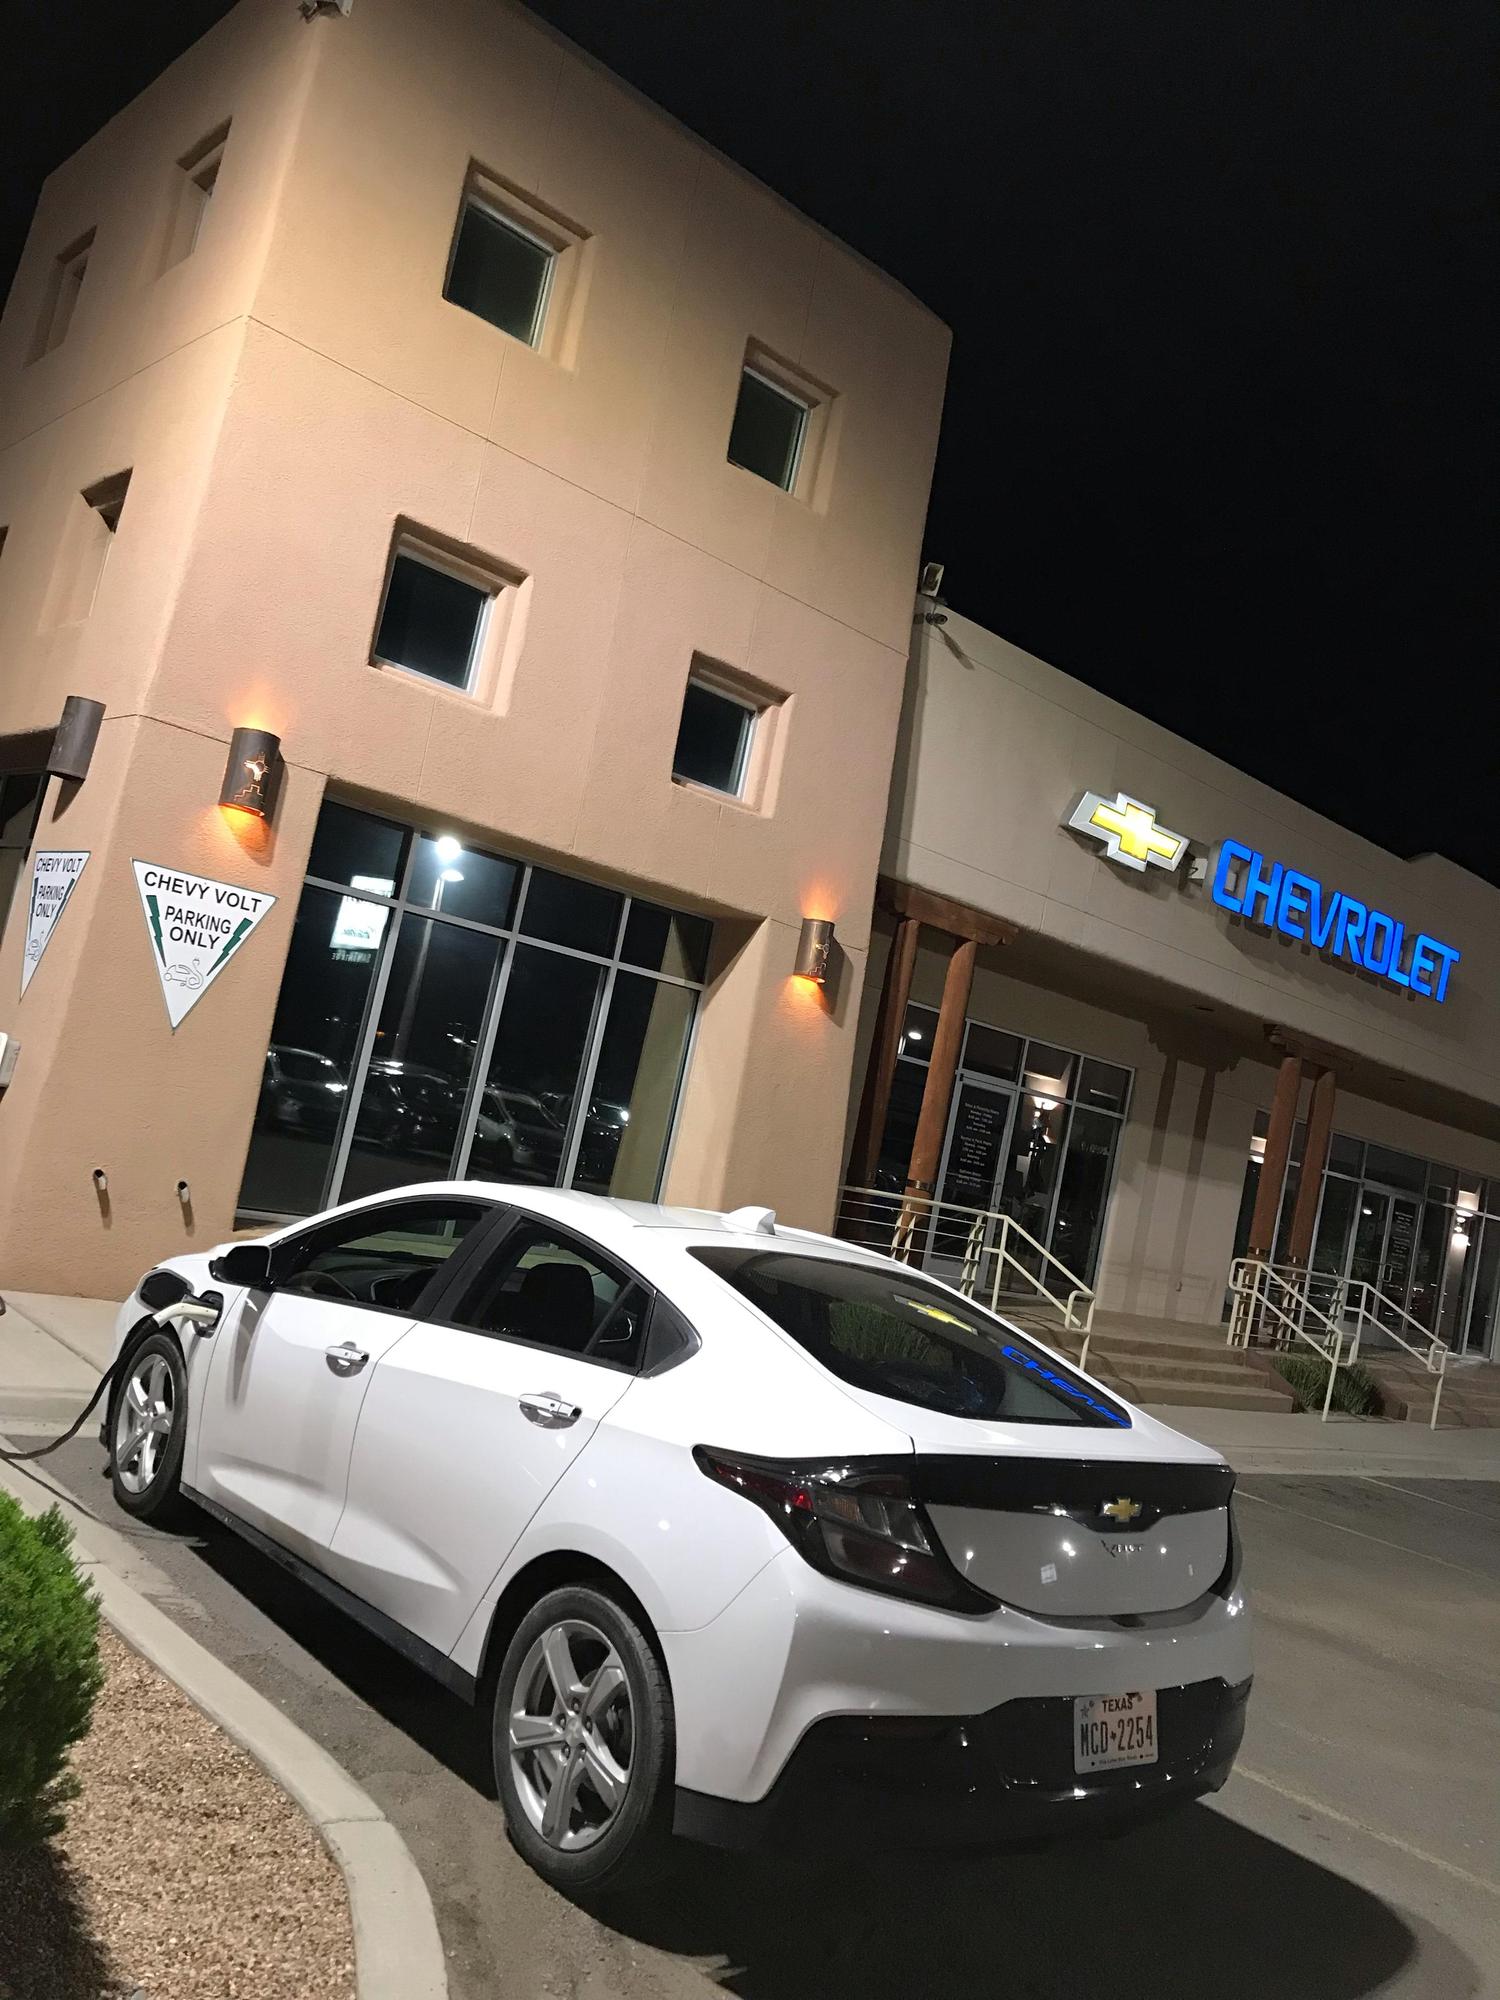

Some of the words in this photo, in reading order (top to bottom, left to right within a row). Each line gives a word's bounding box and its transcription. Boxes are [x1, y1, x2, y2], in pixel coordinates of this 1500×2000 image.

[36, 858, 61, 873] CHEVY
[61, 858, 83, 873] VOLT
[38, 885, 65, 901] PARKING
[144, 870, 210, 899] CHEVY
[214, 888, 262, 913] VOLT
[35, 903, 57, 918] ONLY
[164, 905, 232, 934] PARKING
[1212, 837, 1461, 1004] CHEVROLET
[169, 926, 221, 950] ONLY
[1102, 1697, 1134, 1713] TEXAS
